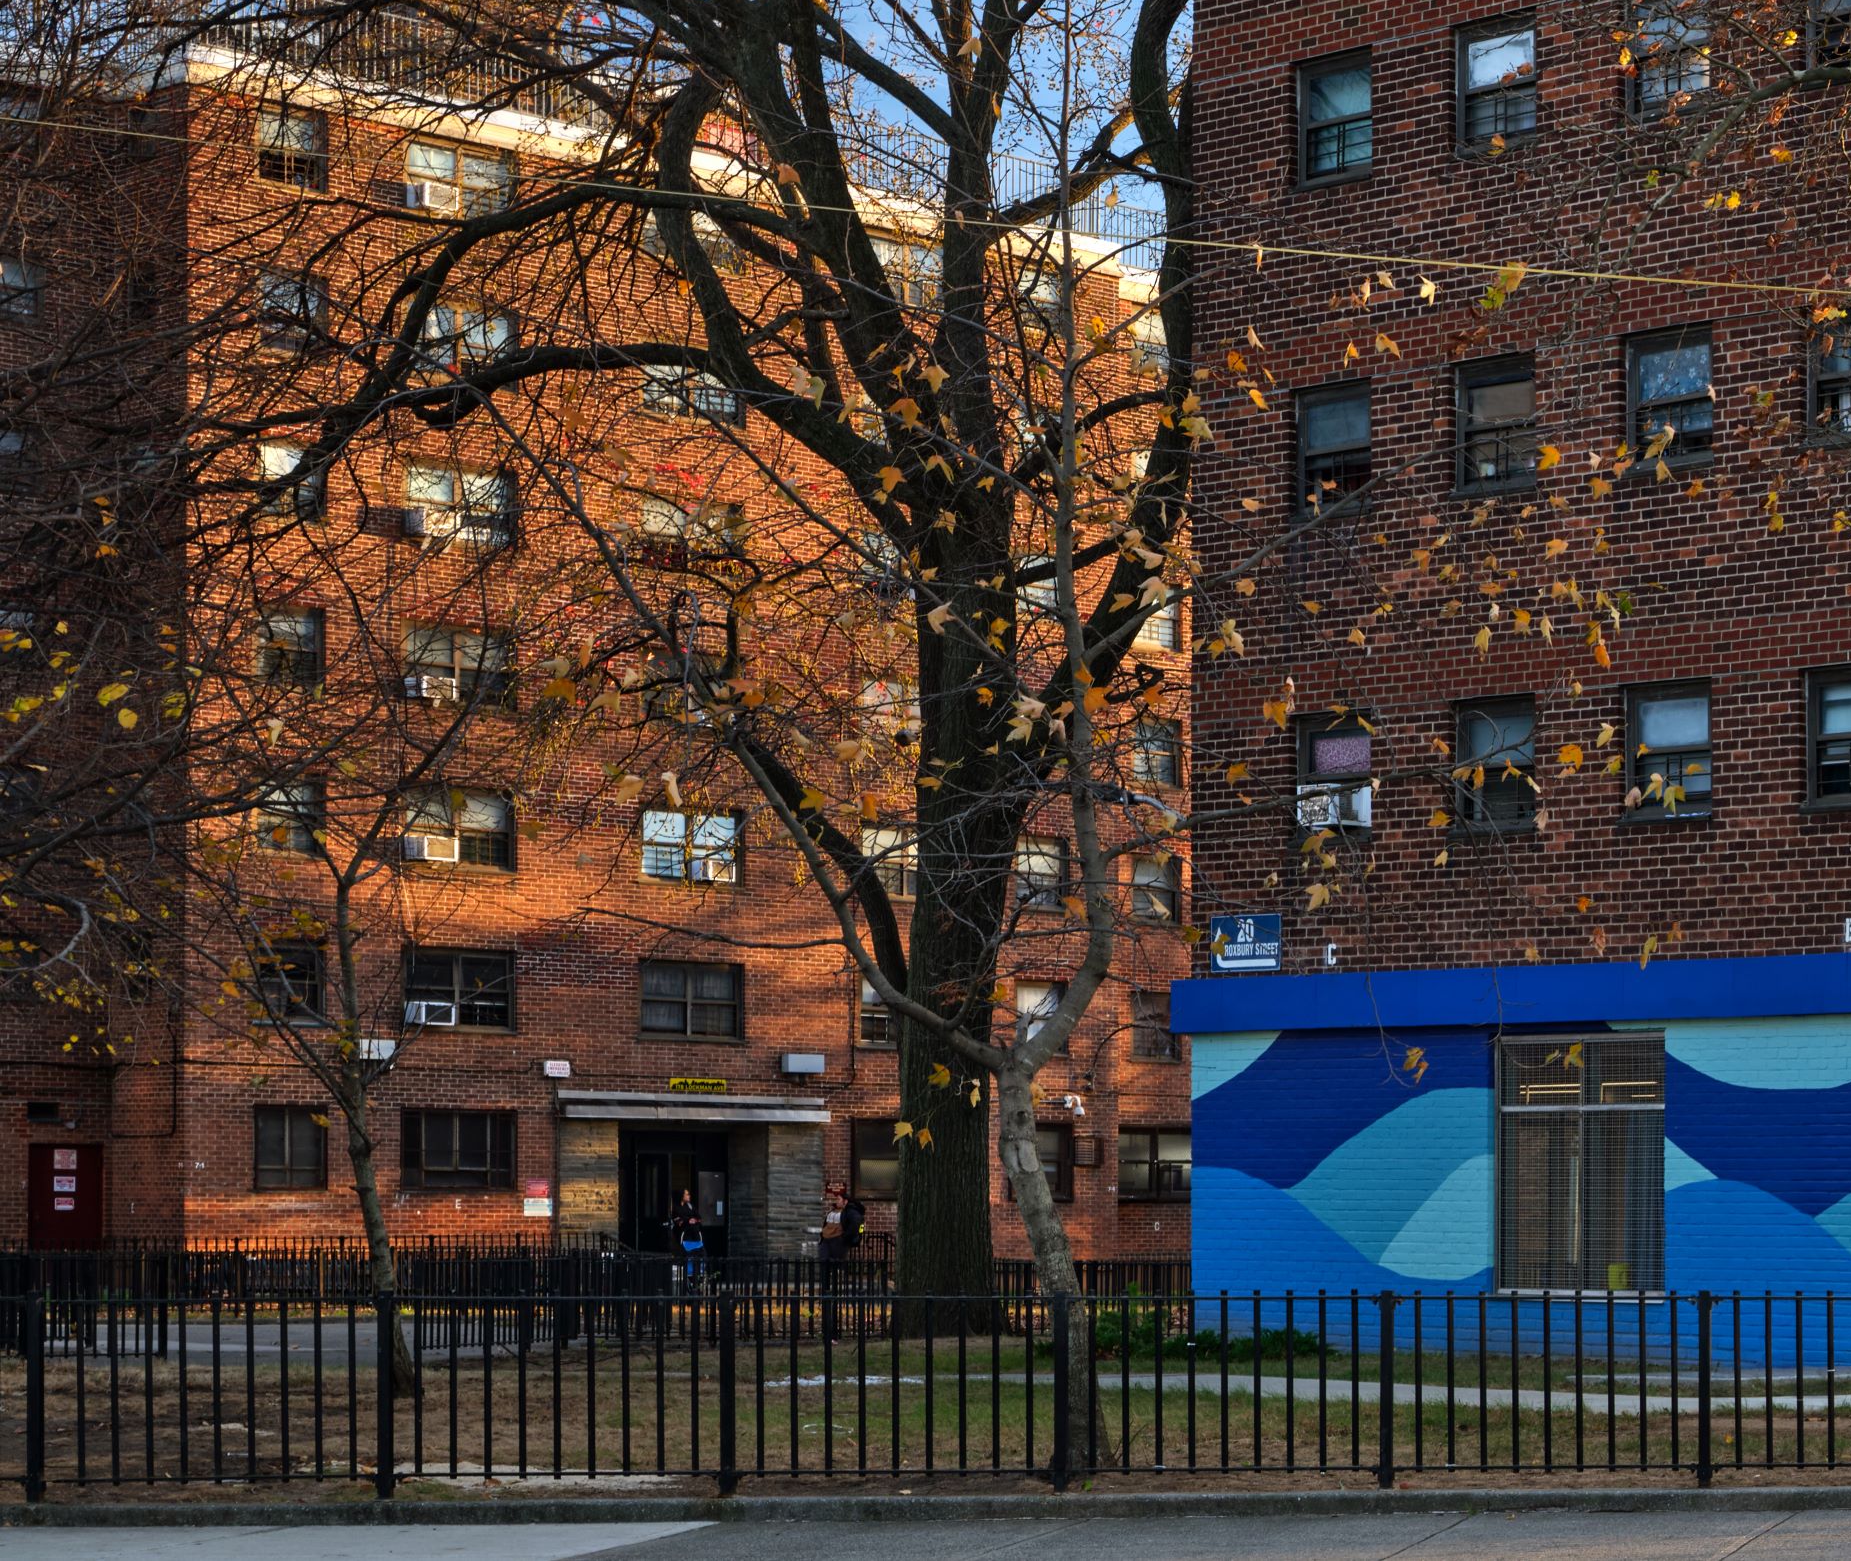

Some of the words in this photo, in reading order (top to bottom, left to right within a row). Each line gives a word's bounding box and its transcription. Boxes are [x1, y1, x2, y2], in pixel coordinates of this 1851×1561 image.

[1237, 918, 1254, 942] 20
[1224, 942, 1254, 957] ROXBURY
[1255, 942, 1279, 956] STREET
[1328, 944, 1336, 965] C
[455, 1199, 462, 1209] E
[1154, 1222, 1160, 1231] C
